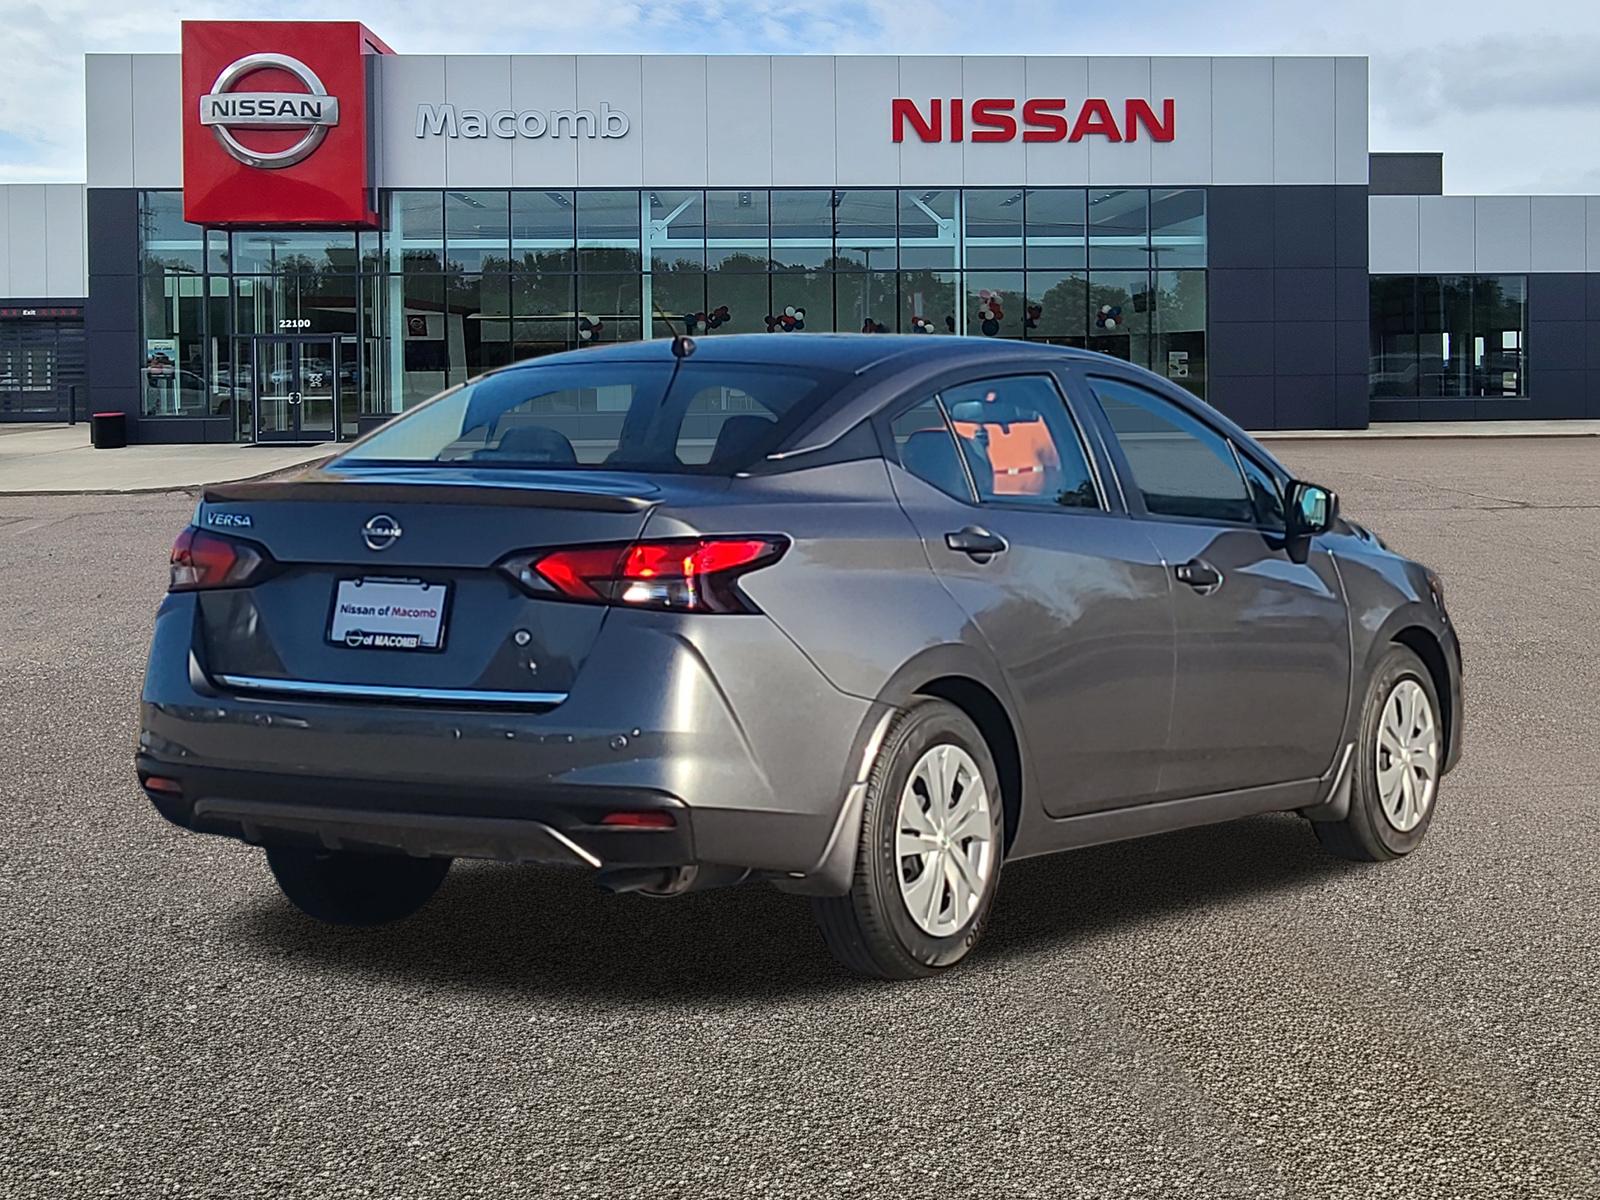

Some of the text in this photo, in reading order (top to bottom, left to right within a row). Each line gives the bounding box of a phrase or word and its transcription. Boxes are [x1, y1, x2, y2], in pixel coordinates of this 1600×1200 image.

[211, 100, 322, 117] NISSAN
[415, 102, 631, 139] Macomb
[892, 98, 1175, 142] NISSAN
[279, 319, 311, 328] 22100
[207, 511, 251, 527] VERSA
[340, 603, 437, 619] Nissan of Macomb
[363, 635, 418, 648] of MACOMB
